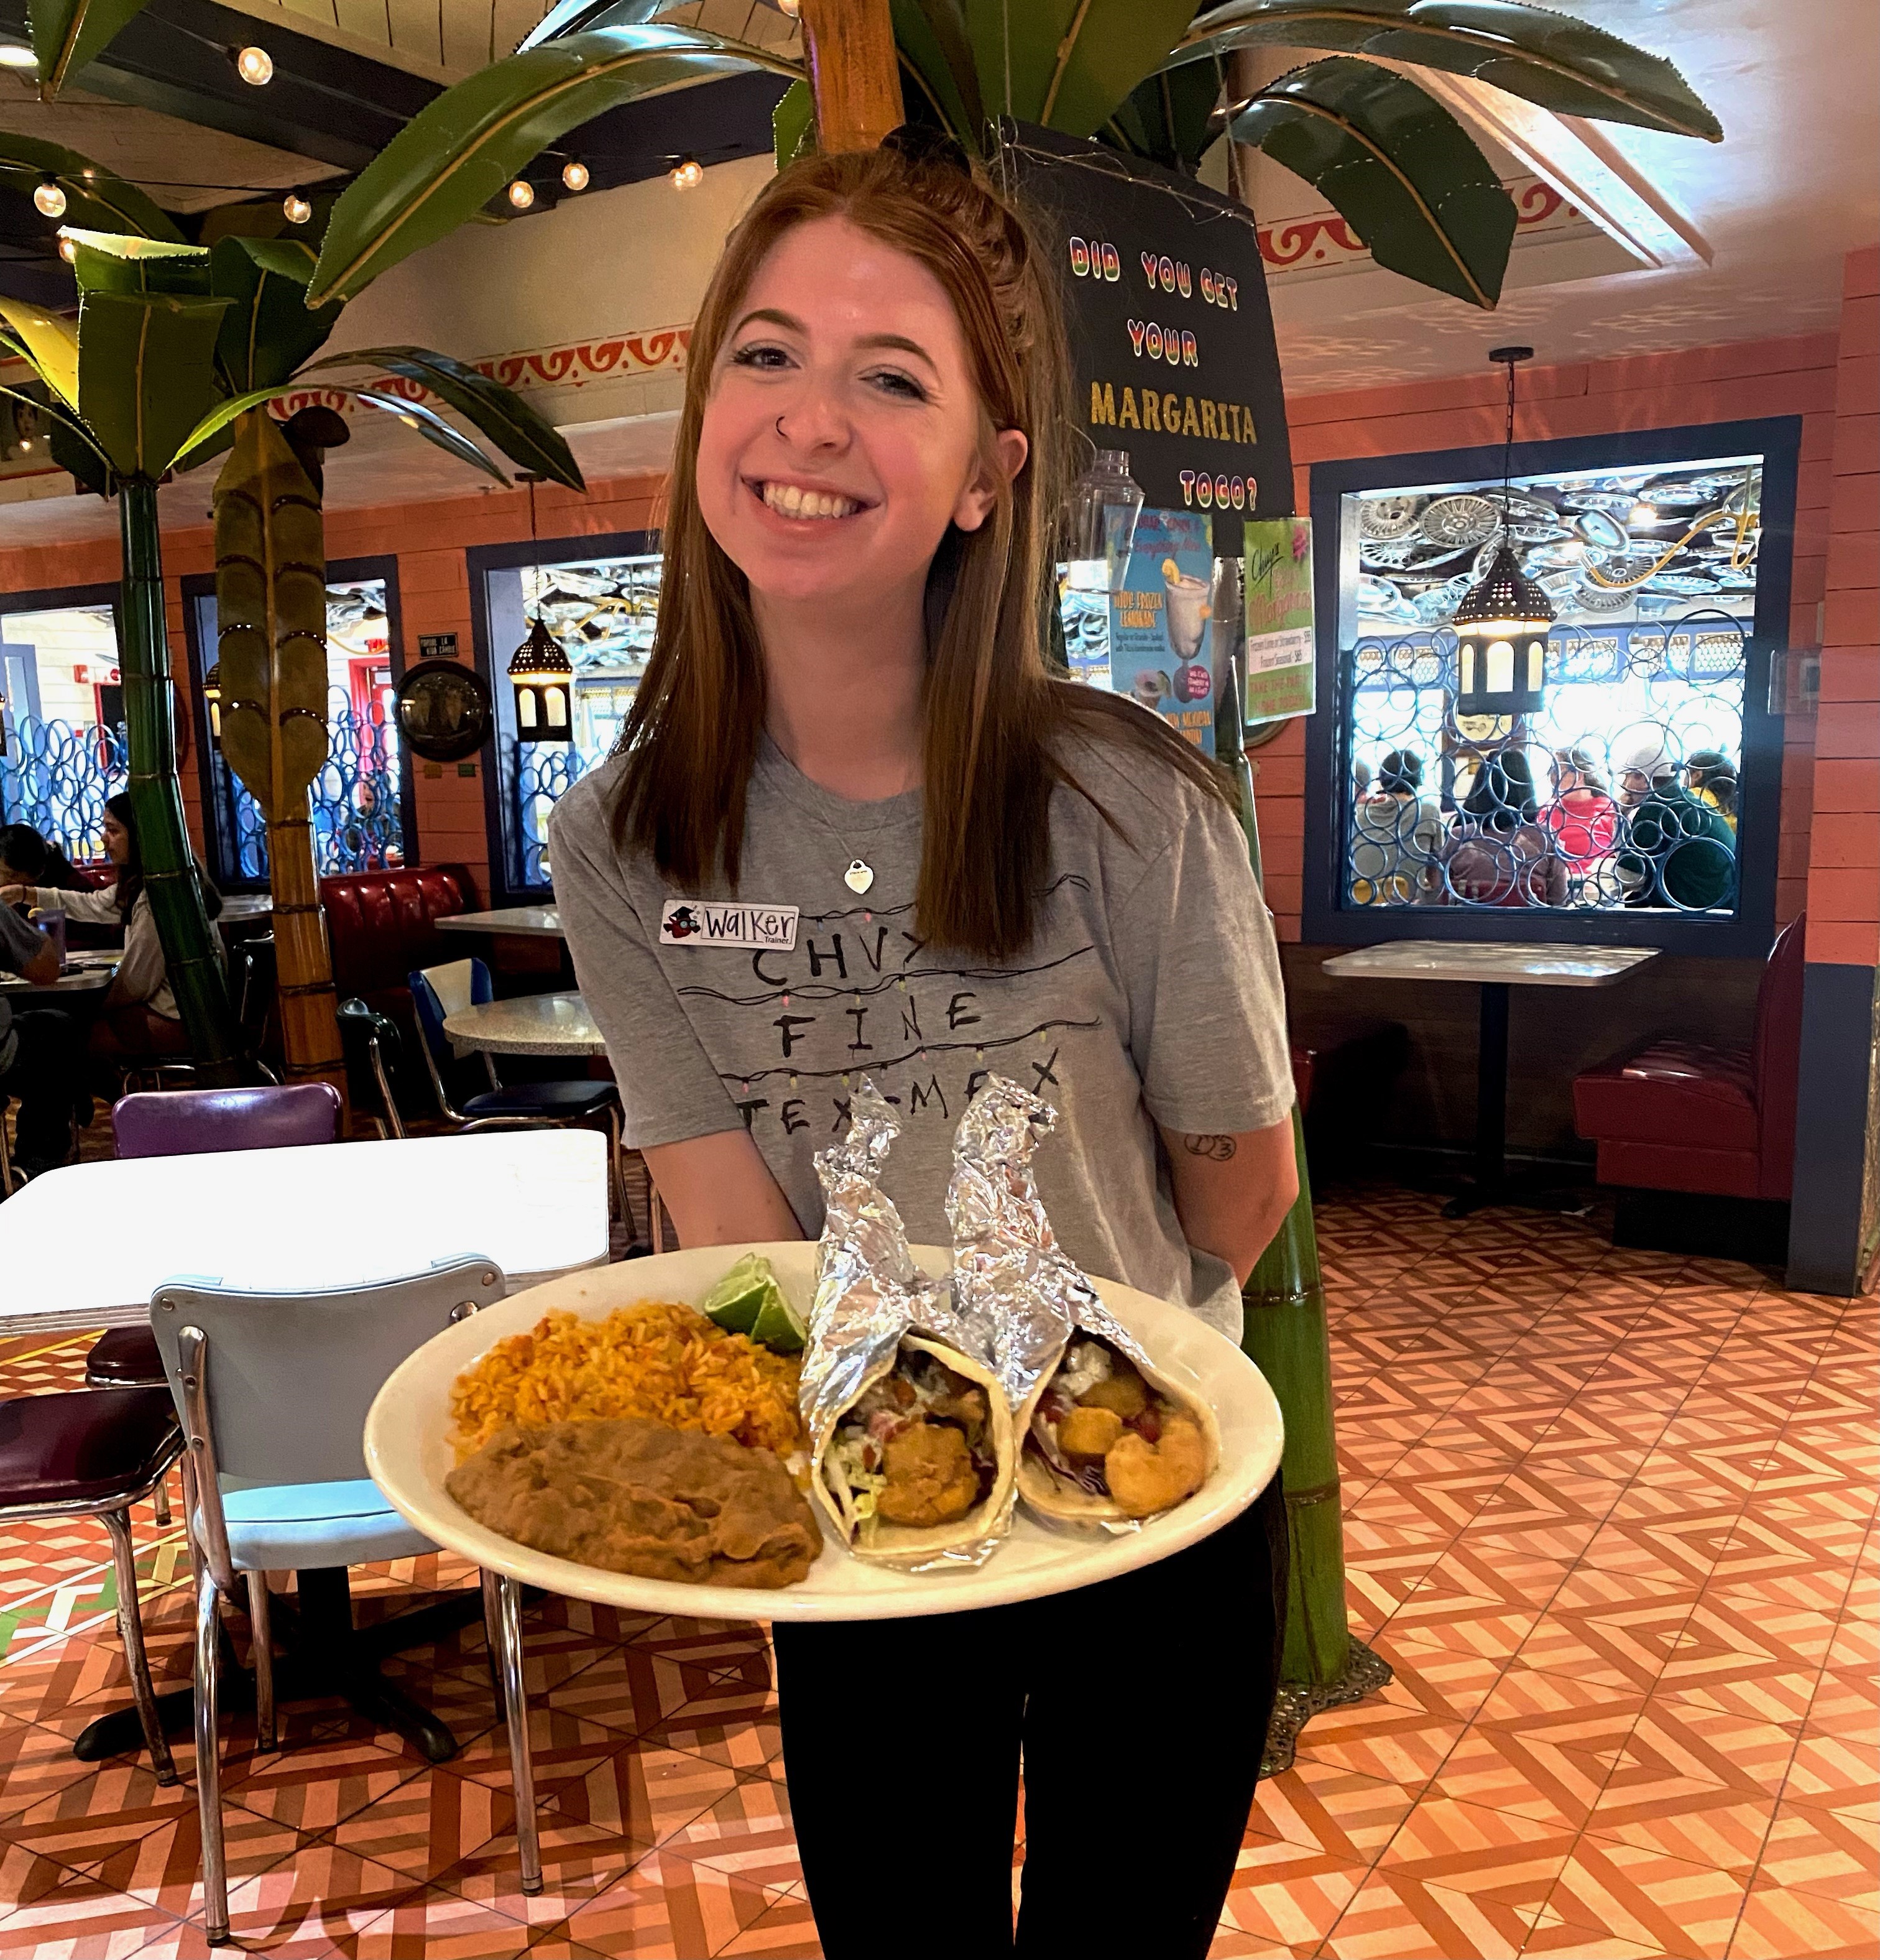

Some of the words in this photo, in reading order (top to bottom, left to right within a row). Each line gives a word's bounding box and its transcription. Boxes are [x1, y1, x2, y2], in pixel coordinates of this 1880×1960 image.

[1069, 236, 1120, 282] DID
[1141, 251, 1192, 298] YOU
[1200, 267, 1238, 311] GET
[1127, 318, 1198, 367] YOUR
[1091, 381, 1256, 445] MARGARITA
[1179, 469, 1257, 511] TOGO?
[706, 910, 795, 940] Walker
[773, 992, 982, 1058] FINE
